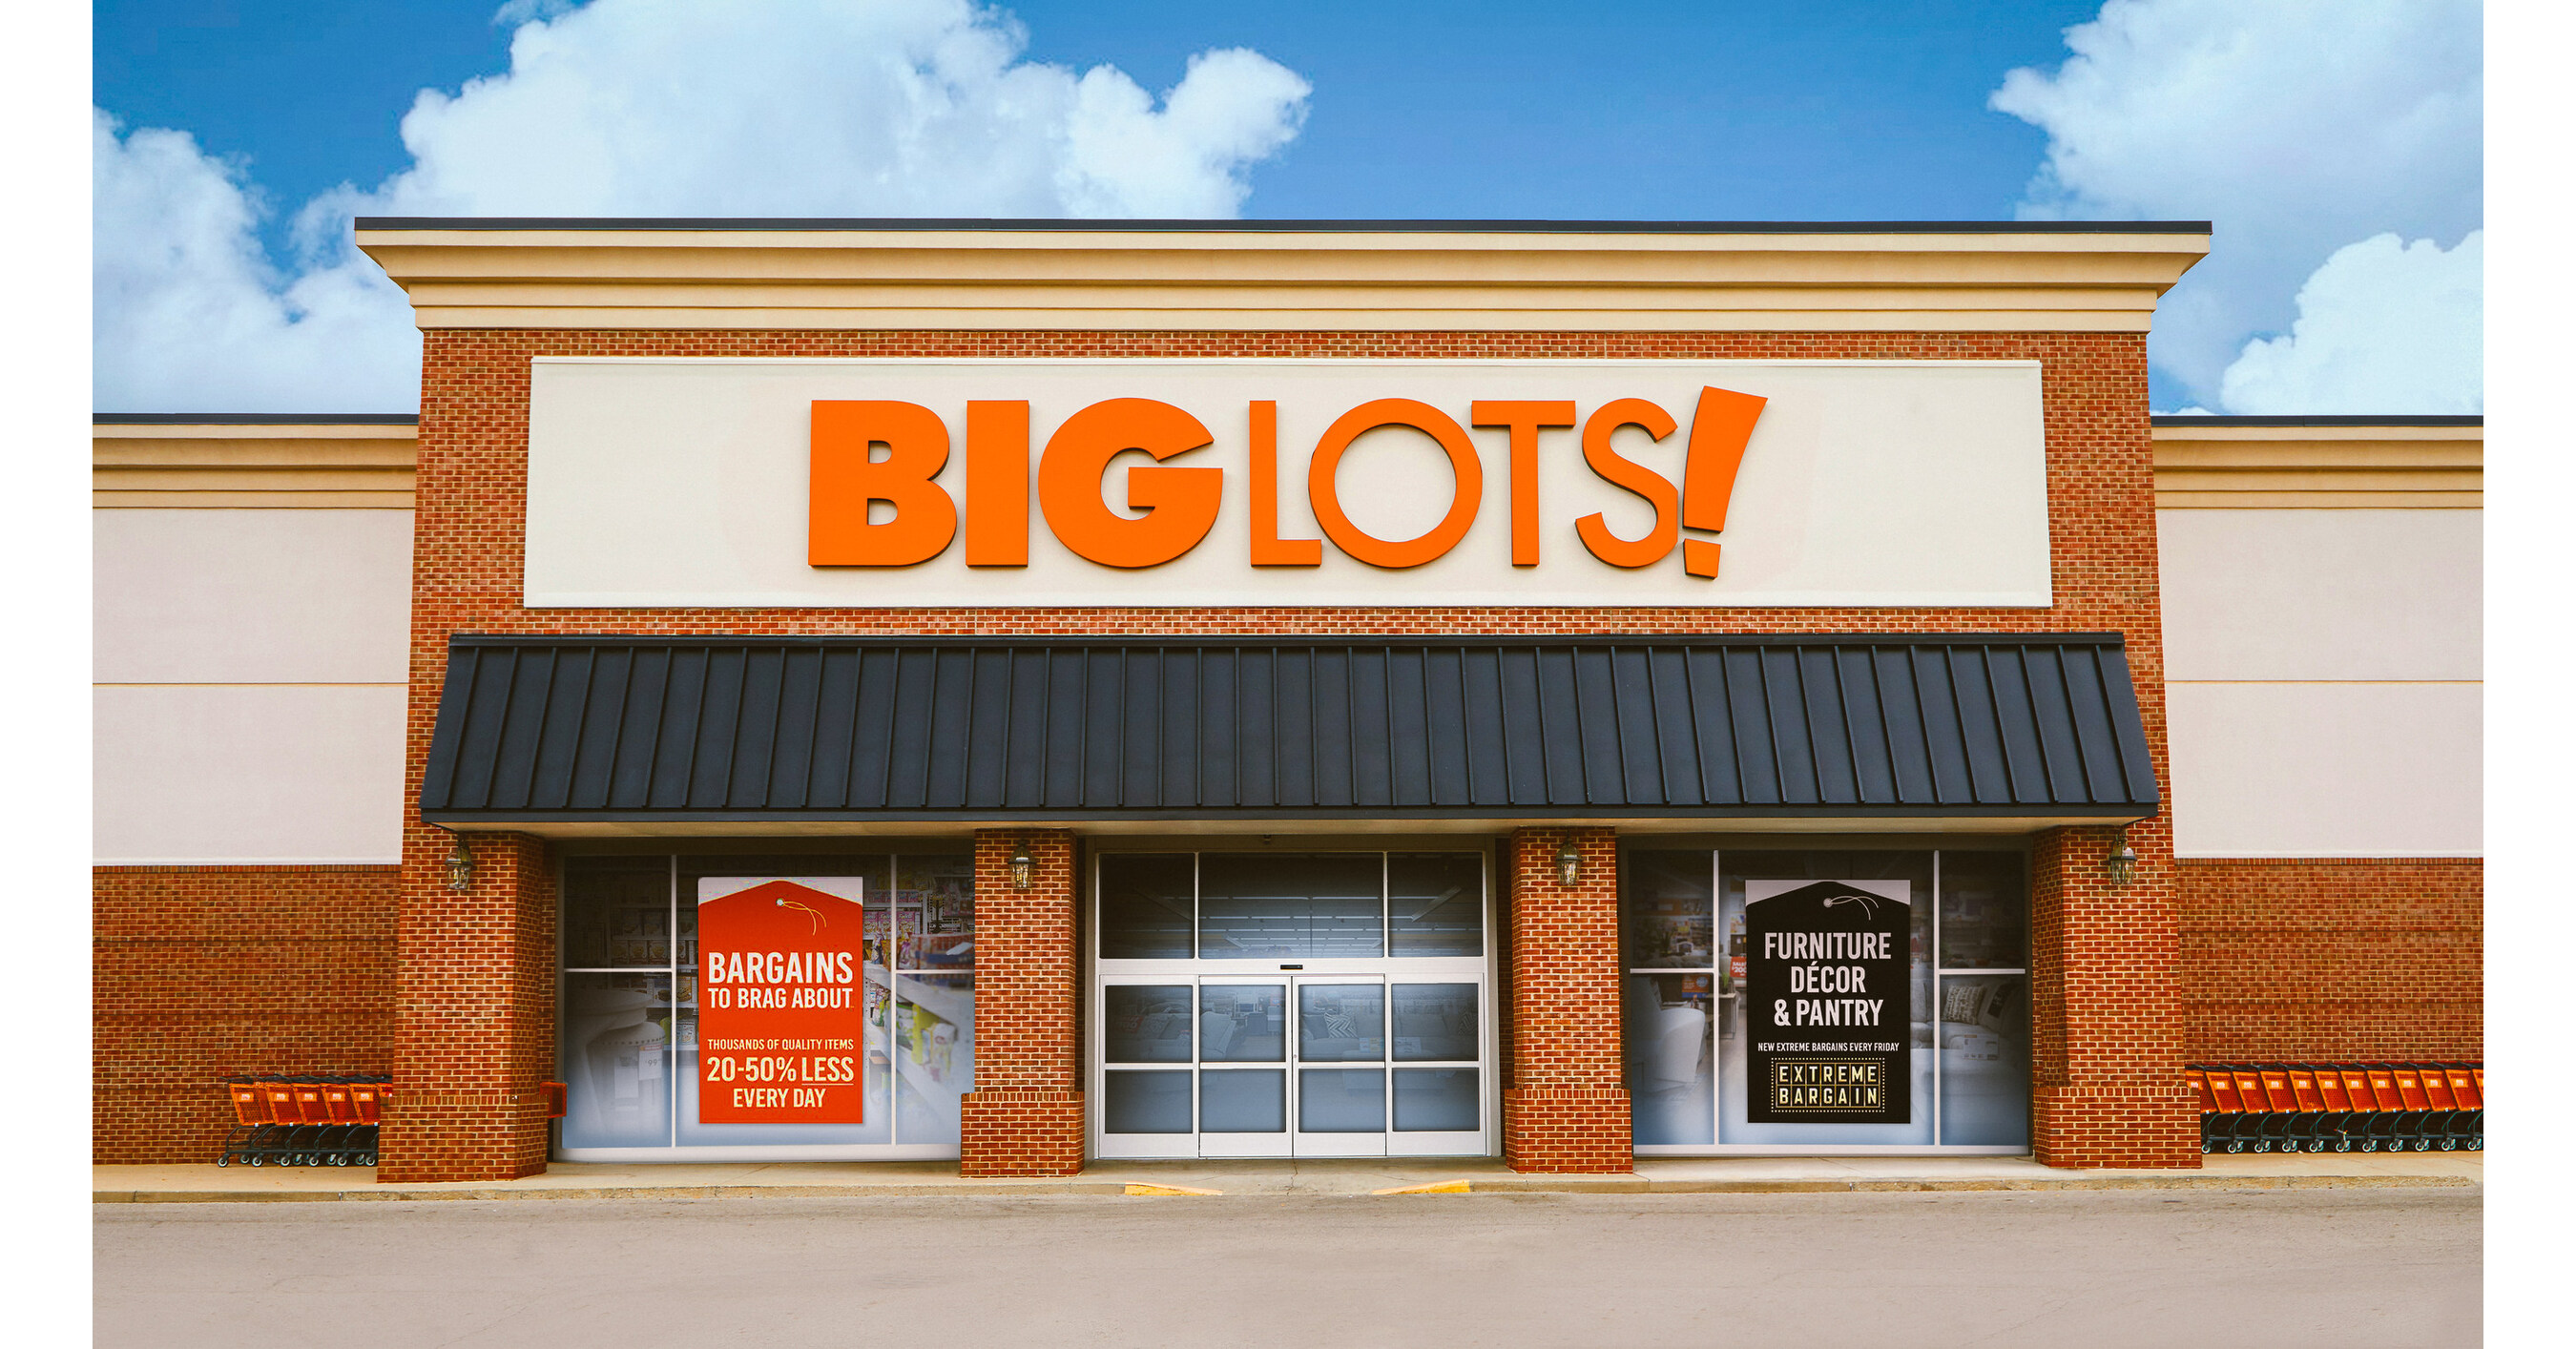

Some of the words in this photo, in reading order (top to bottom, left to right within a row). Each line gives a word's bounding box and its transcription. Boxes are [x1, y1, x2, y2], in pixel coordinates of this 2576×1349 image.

[808, 397, 1223, 570] BIG
[1248, 385, 1768, 580] LOTS!
[1765, 932, 1892, 960] FURNITURE
[708, 951, 854, 985] BARGAINS
[1791, 961, 1866, 993] DÉCOR
[708, 987, 731, 1008] TO
[737, 987, 786, 1008] BRAG
[791, 987, 854, 1008] ABOUT
[1774, 998, 1791, 1027] &
[1796, 999, 1884, 1027] PANTRY
[708, 1039, 765, 1050] THOUSANDS
[766, 1039, 779, 1050] OF
[781, 1039, 822, 1050] QUALITY
[824, 1039, 854, 1050] ITEMS
[1757, 1042, 1775, 1051] NEW
[1776, 1042, 1810, 1051] EXTREME
[1812, 1042, 1848, 1051] BARGAINS
[1849, 1042, 1873, 1051] EVERY
[1874, 1042, 1900, 1051] FRIDAY
[707, 1056, 797, 1082] 20-50%
[801, 1056, 854, 1082] LESS
[1779, 1066, 1878, 1083] EXTREME
[733, 1088, 789, 1108] EVERY
[793, 1088, 826, 1108] DAY
[1779, 1088, 1878, 1105] BARGAIN
